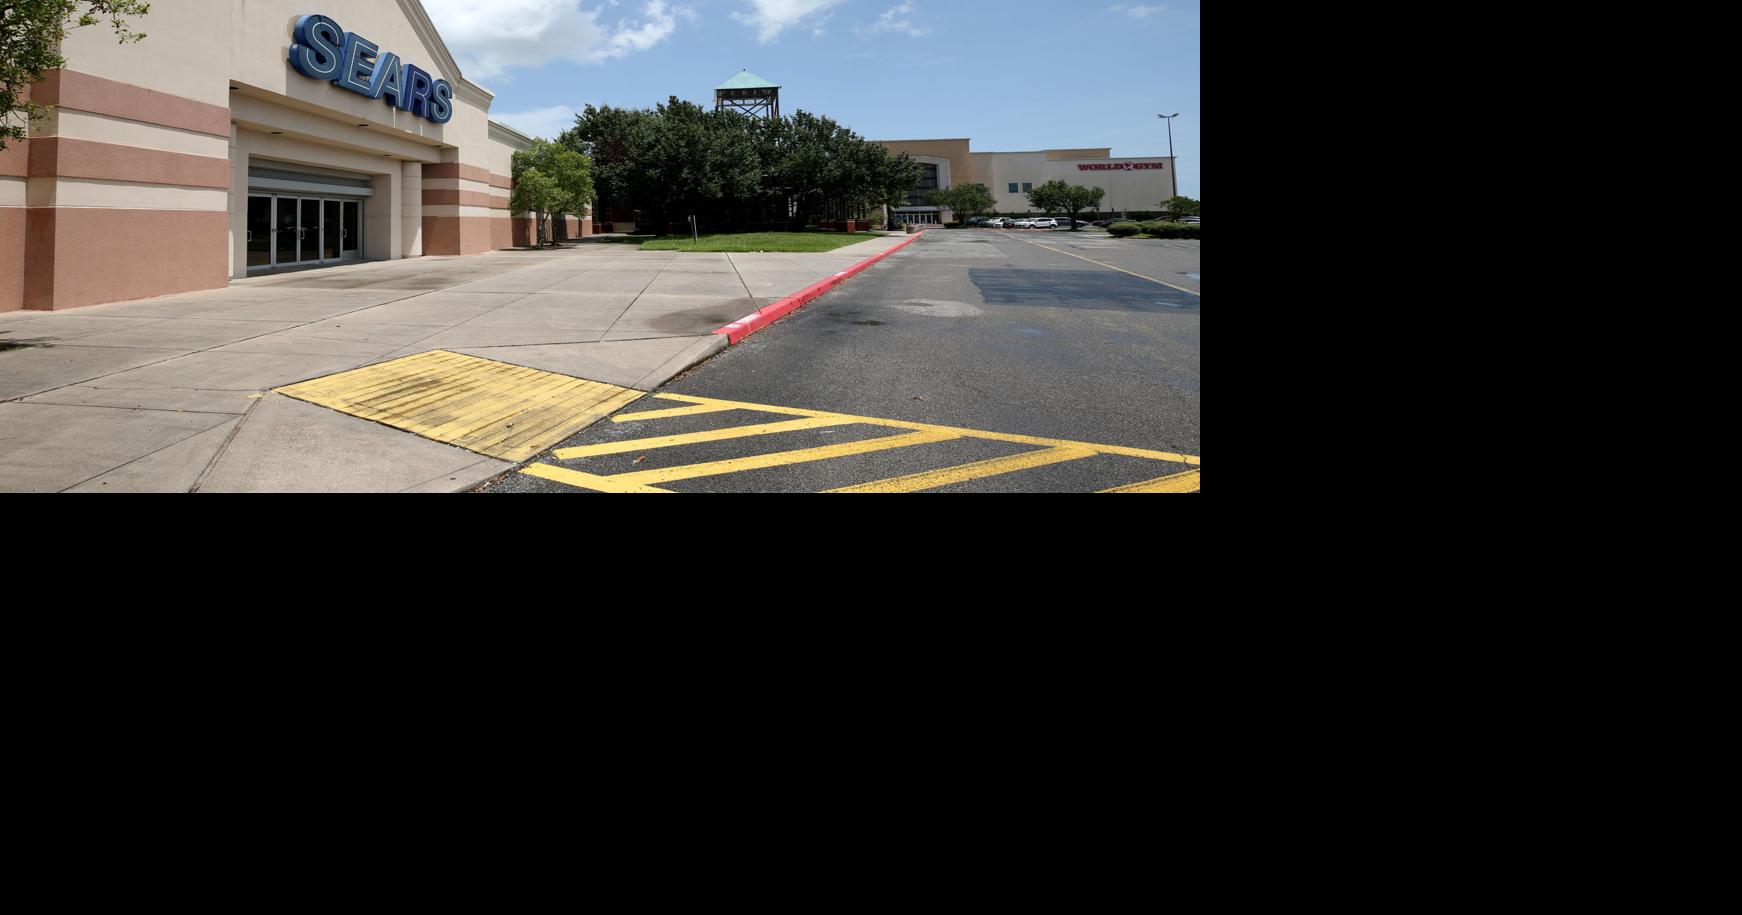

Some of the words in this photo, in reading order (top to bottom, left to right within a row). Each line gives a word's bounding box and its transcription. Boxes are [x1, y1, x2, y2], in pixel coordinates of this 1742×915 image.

[289, 14, 453, 124] SEARS
[1077, 163, 1123, 171] WORLD
[1134, 162, 1163, 170] GYM
